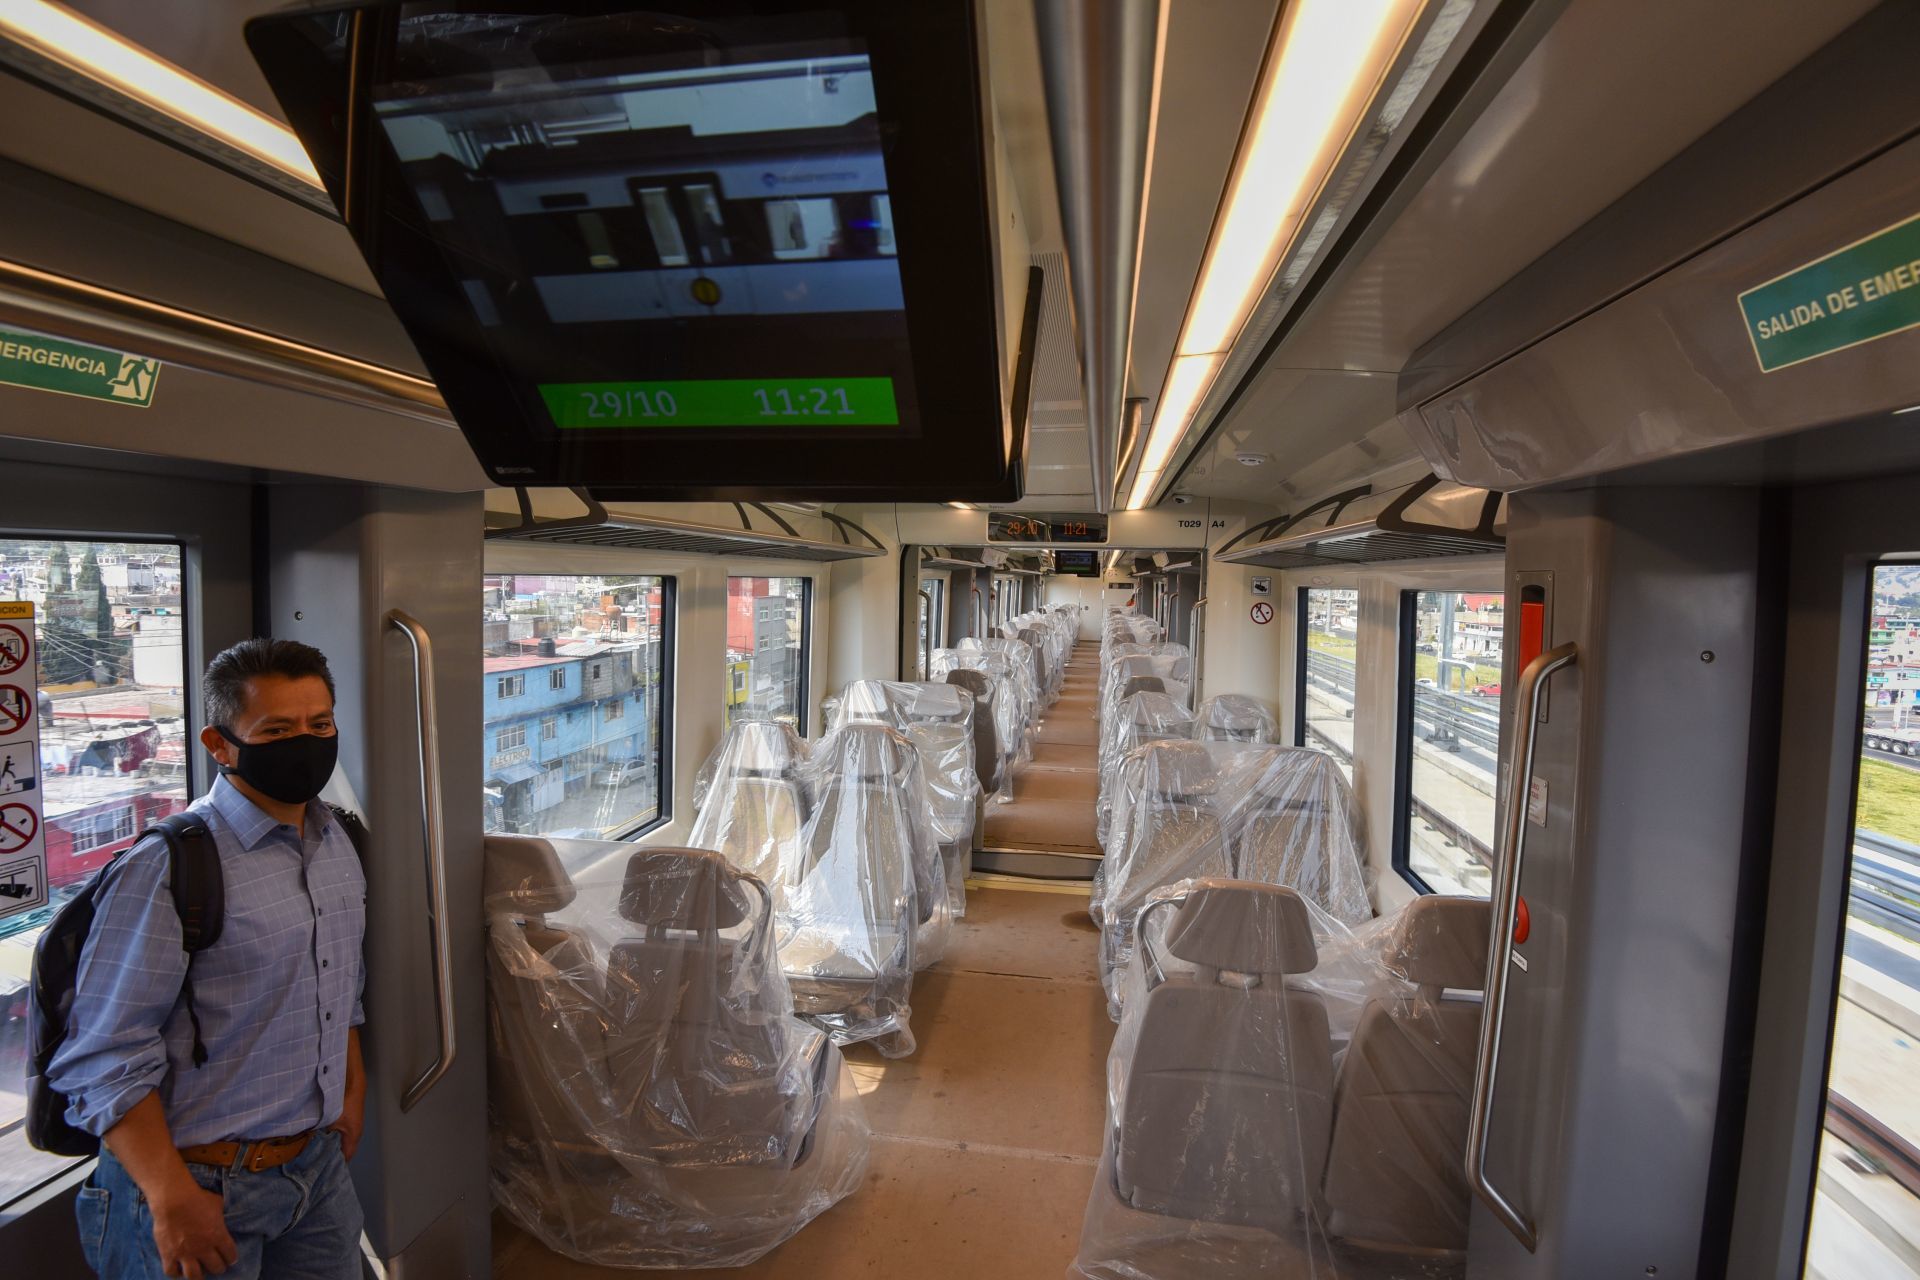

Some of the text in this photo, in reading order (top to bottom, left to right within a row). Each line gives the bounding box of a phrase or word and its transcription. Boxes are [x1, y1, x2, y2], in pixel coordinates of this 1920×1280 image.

[1757, 300, 1825, 340] SALIDA
[1826, 286, 1859, 315] DE
[0, 341, 107, 376] ERGENCIA
[581, 390, 677, 418] 29/10
[753, 387, 856, 416] 11:21
[1178, 520, 1225, 528] T029 A4
[0, 606, 26, 614] CION
